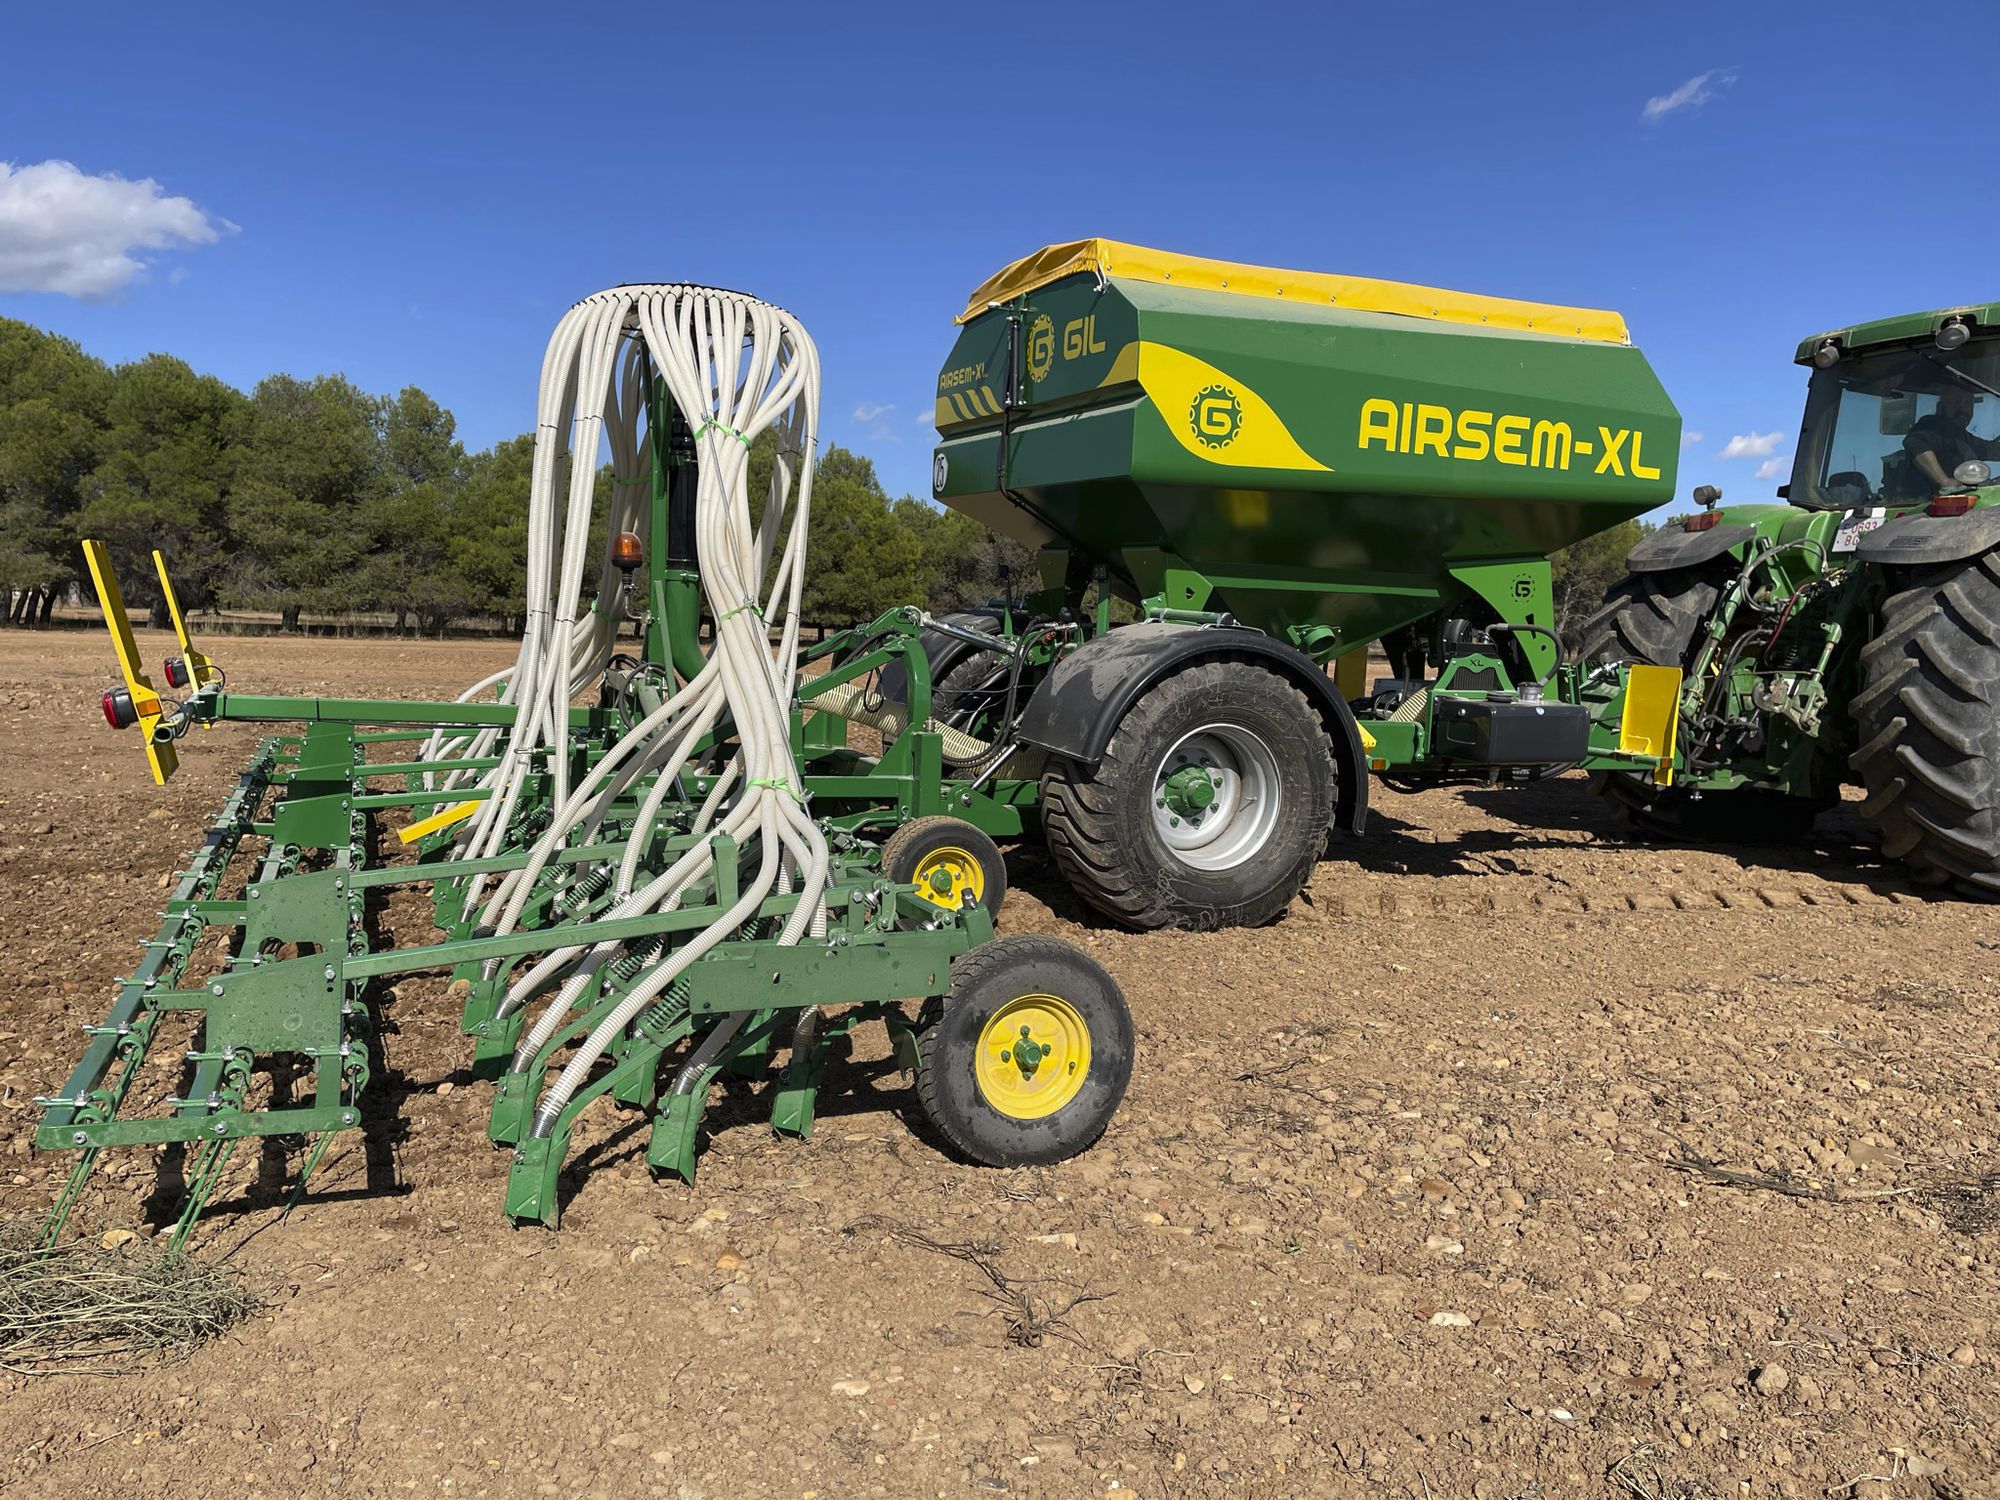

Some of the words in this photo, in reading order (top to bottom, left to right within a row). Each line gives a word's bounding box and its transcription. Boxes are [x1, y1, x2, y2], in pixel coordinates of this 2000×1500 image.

[1063, 314, 1106, 361] GIL
[940, 362, 988, 390] AIRSEM-XL
[1200, 398, 1232, 436] G
[1358, 398, 1660, 480] AIRSEM-XL
[1515, 580, 1531, 597] G
[1470, 659, 1484, 667] XL
